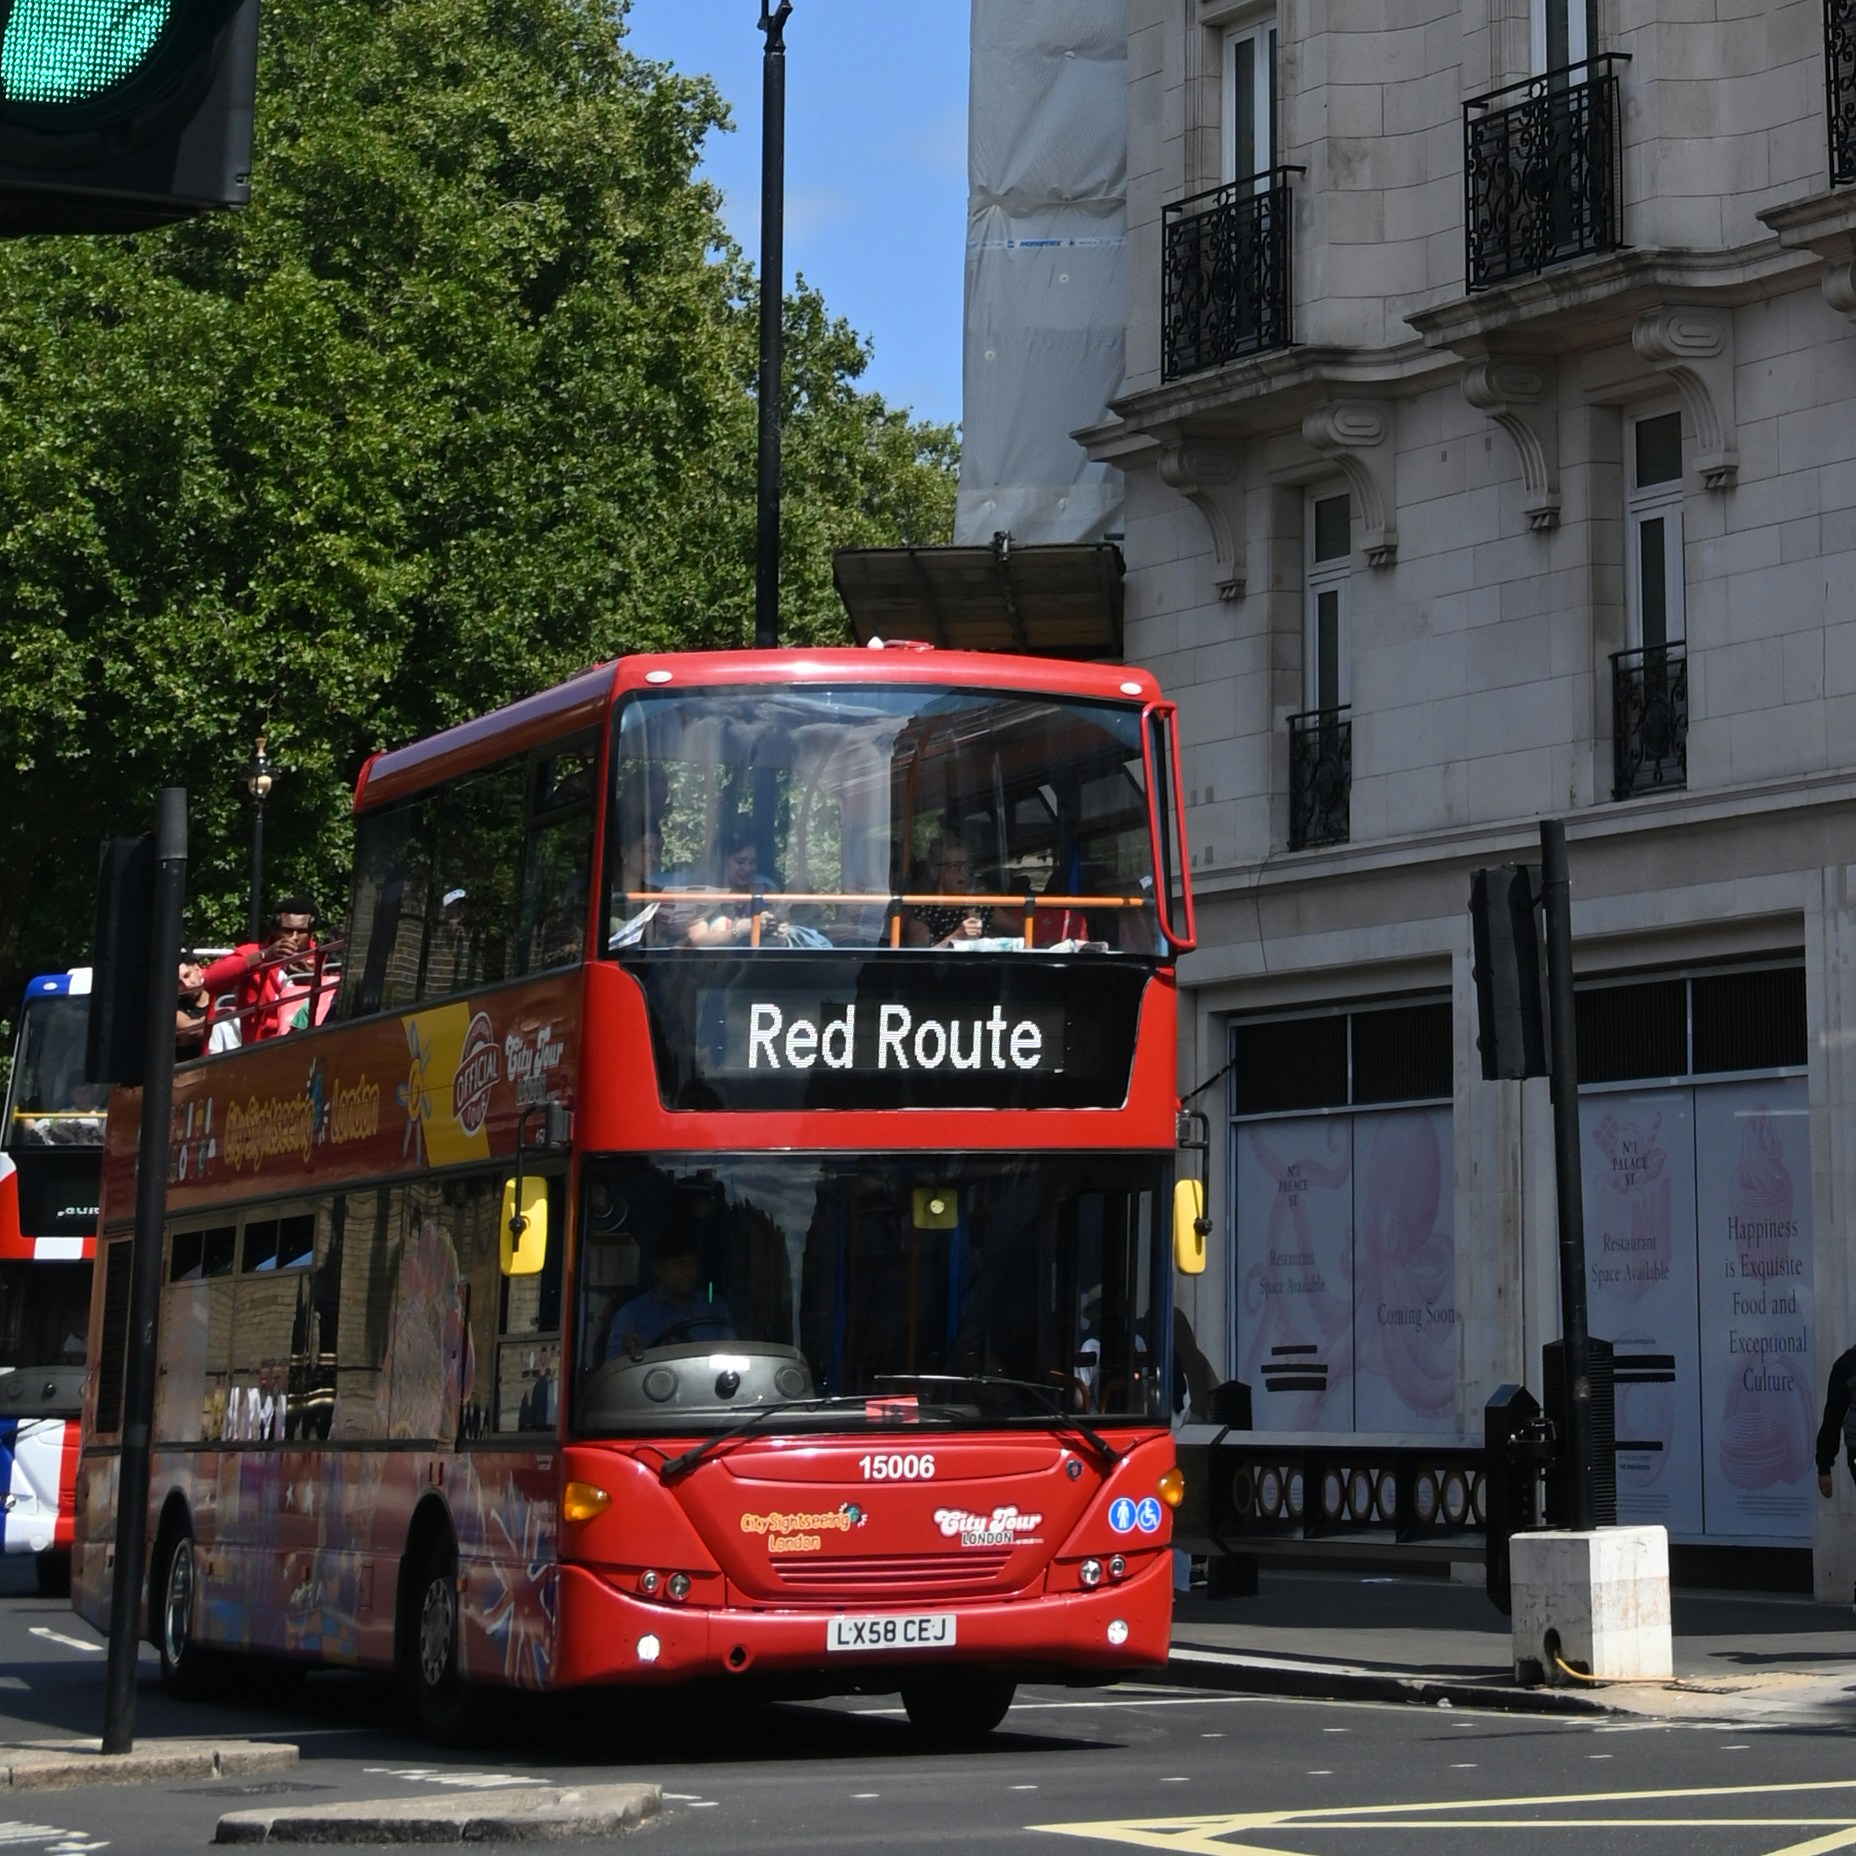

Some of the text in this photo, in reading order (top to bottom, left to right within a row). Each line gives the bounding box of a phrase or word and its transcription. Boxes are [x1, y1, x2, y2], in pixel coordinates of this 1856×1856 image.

[749, 1004, 1041, 1068] Red Route
[505, 1035, 533, 1081] City
[533, 1026, 564, 1077] Tour
[457, 1050, 498, 1108] OFFICIAL
[331, 1074, 379, 1145] London
[1612, 1156, 1648, 1171] PALACE
[1603, 1233, 1656, 1253] Restaurant
[1728, 1217, 1798, 1242] Happiness
[1592, 1264, 1669, 1288] Space Available
[1725, 1255, 1802, 1285] is Exquisite
[1733, 1290, 1797, 1316] Food and
[1378, 1302, 1455, 1332] Coming Soon
[1729, 1327, 1807, 1360] Exceptional
[1743, 1366, 1794, 1393] Culture
[859, 1454, 934, 1480] 15006
[934, 1505, 1043, 1537] City Tour
[768, 1533, 821, 1552] London
[962, 1531, 1013, 1546] LONDON
[837, 1618, 946, 1645] LX58 CEJ
